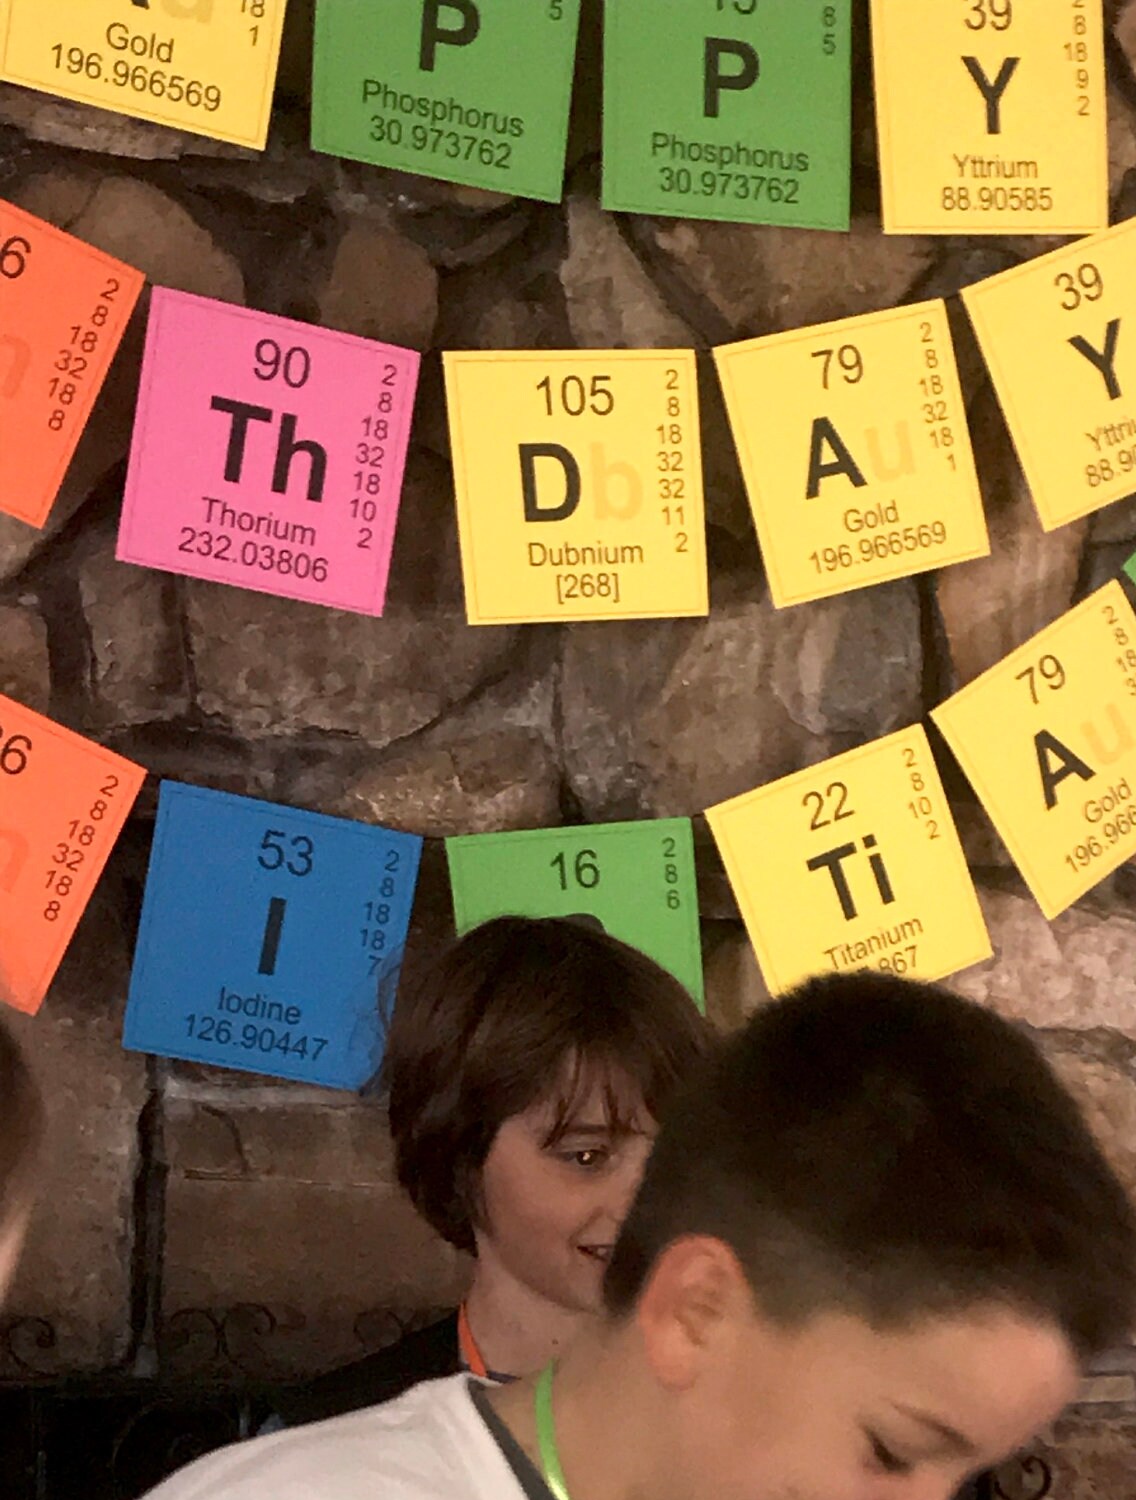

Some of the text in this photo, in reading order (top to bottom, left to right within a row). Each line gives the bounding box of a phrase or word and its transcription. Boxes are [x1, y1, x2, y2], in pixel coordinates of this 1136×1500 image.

[822, 6, 836, 28] 8
[964, 0, 1013, 31] 39
[106, 22, 174, 63] Gold
[249, 25, 259, 46] 1
[419, 0, 480, 72] P
[822, 33, 836, 56] 5
[1063, 41, 1088, 63] 18
[51, 43, 221, 112] 196.966569
[704, 36, 760, 118] P
[1076, 68, 1089, 89] 9
[961, 55, 1021, 135] Y
[1077, 95, 1090, 117] 2
[362, 79, 525, 138] Phosphorus
[369, 114, 512, 170] 30.973762
[651, 131, 810, 172] Phosphorus
[953, 153, 1039, 179] Yttrium
[659, 166, 799, 205] 30.973762
[942, 186, 1053, 211] 88.90585
[100, 278, 119, 302] 2
[1053, 262, 1104, 311] 39
[92, 305, 109, 327] 8
[70, 326, 98, 353] 18
[920, 322, 934, 343] 2
[54, 350, 88, 380] 32
[252, 338, 311, 389] 90
[811, 344, 864, 390] 79
[925, 349, 938, 369] 8
[1066, 317, 1122, 401] Y
[381, 364, 398, 387] 2
[665, 369, 680, 390] 2
[918, 375, 944, 397] 18
[48, 377, 76, 405] 18
[378, 392, 392, 412] 8
[536, 374, 615, 416] 105
[667, 397, 680, 417] 8
[923, 401, 948, 424] 32
[48, 409, 66, 431] 8
[360, 417, 389, 442] 18
[655, 424, 683, 445] 18
[929, 427, 954, 448] 18
[209, 394, 328, 503] Th
[355, 444, 385, 468] 32
[656, 451, 684, 472] 32
[946, 454, 957, 471] 1
[353, 472, 381, 495] 18
[658, 478, 685, 499] 32
[201, 496, 317, 548] Thorium
[349, 500, 377, 523] 10
[661, 506, 685, 526] 11
[843, 499, 900, 534] Gold
[357, 528, 372, 549] 2
[675, 532, 689, 553] 2
[808, 520, 947, 575] 196.966569
[178, 526, 329, 583] 232.03806
[527, 540, 644, 567] Dubnium
[555, 572, 621, 605] [268]
[1101, 605, 1118, 625] 2
[1114, 628, 1129, 646] 8
[1014, 653, 1066, 705] 79
[0, 734, 33, 775] 6
[901, 748, 917, 768] 2
[100, 775, 119, 797] 2
[911, 772, 925, 792] 8
[90, 800, 108, 821] 8
[801, 781, 856, 831] 22
[908, 797, 933, 819] 10
[1083, 777, 1132, 824] Gold
[68, 819, 95, 846] 18
[925, 820, 941, 840] 2
[52, 842, 84, 872] 32
[257, 829, 314, 877] 53
[662, 838, 676, 857] 2
[385, 851, 400, 872] 2
[550, 849, 600, 891] 16
[45, 870, 73, 896] 18
[665, 864, 678, 884] 8
[806, 833, 896, 922] Ti
[380, 877, 394, 898] 8
[44, 900, 61, 921] 8
[667, 890, 681, 910] 6
[364, 902, 391, 925] 18
[257, 896, 286, 976] I
[359, 928, 385, 951] 18
[822, 918, 924, 970] Titanium
[368, 956, 381, 976] 7
[857, 945, 918, 975] 867
[218, 986, 301, 1025] Iodine
[184, 1013, 329, 1062] 126.90447
